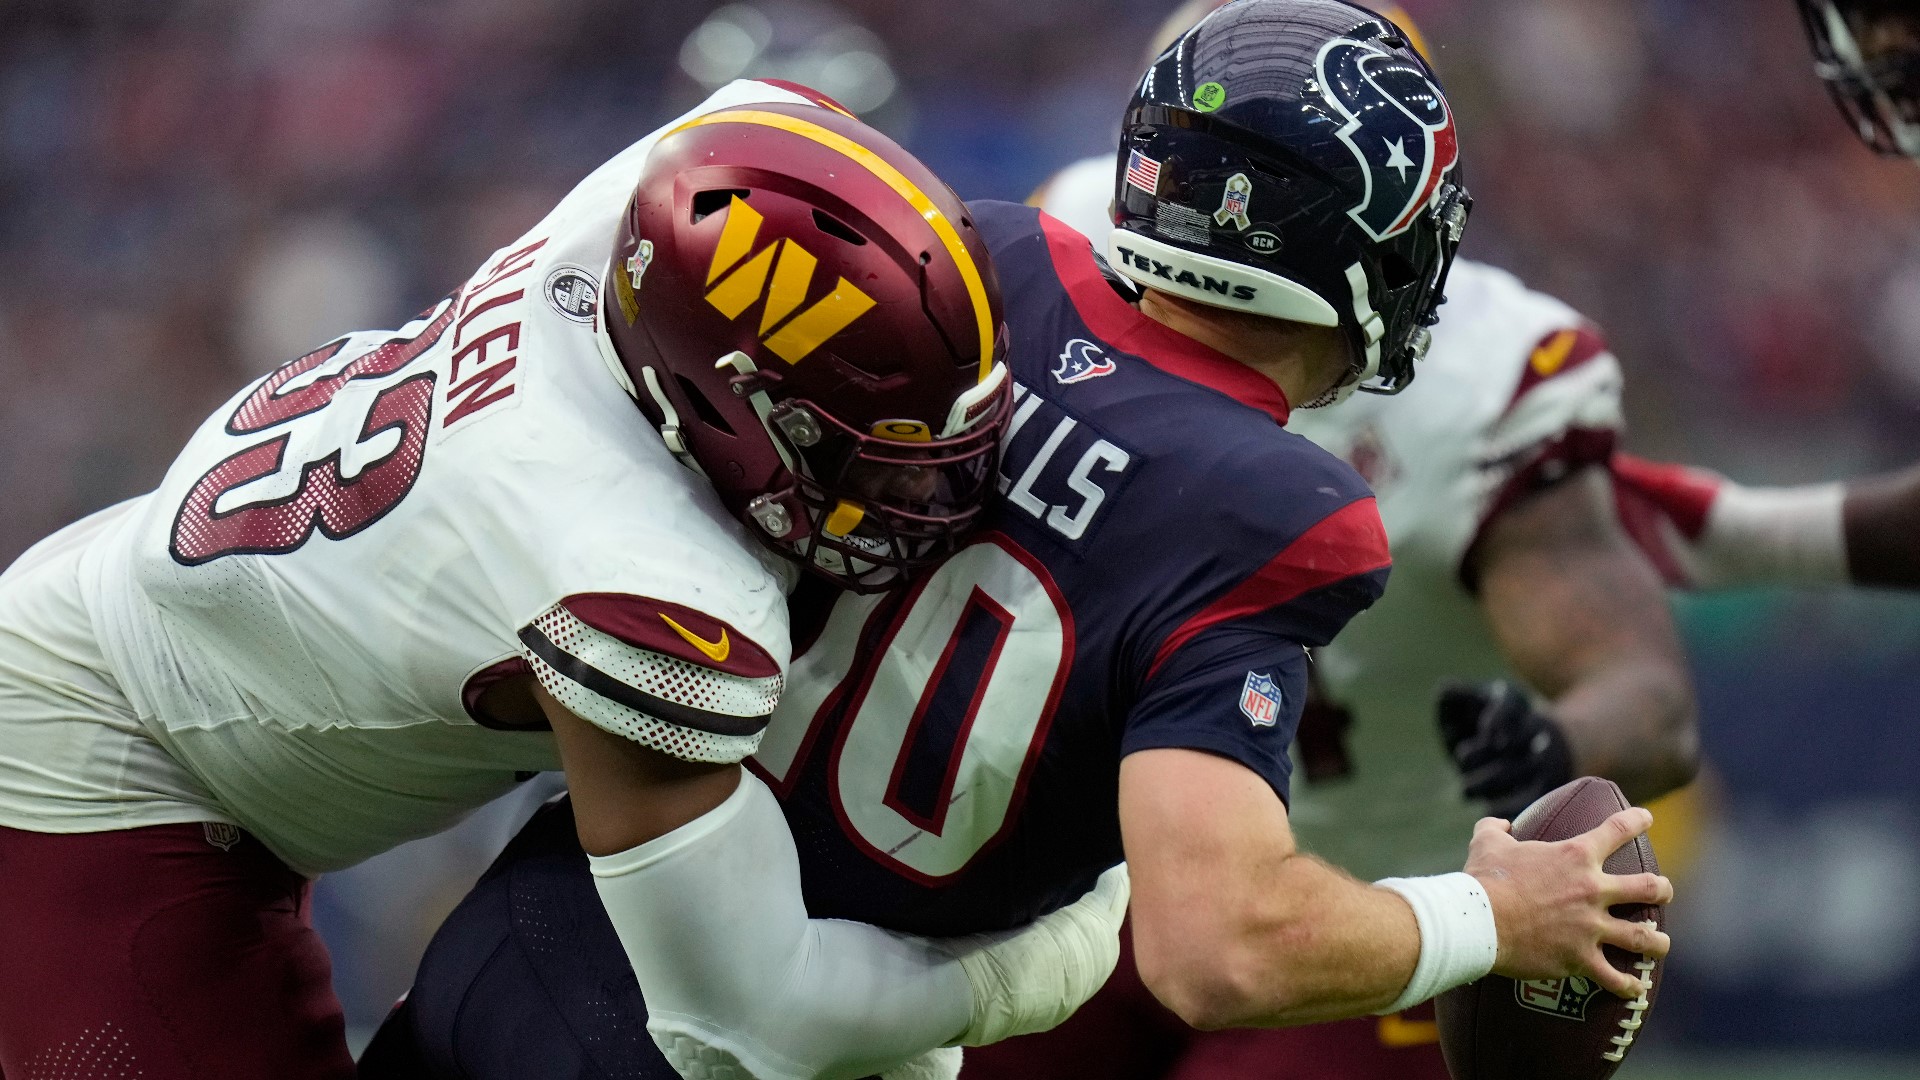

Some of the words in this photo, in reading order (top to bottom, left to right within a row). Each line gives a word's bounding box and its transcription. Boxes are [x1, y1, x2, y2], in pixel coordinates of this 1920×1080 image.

[1226, 200, 1244, 214] NFL
[704, 193, 877, 366] W
[1117, 245, 1257, 300] TEXANS
[443, 236, 550, 428] ALLEN
[998, 382, 1121, 540] LLS
[1244, 690, 1272, 720] NFL
